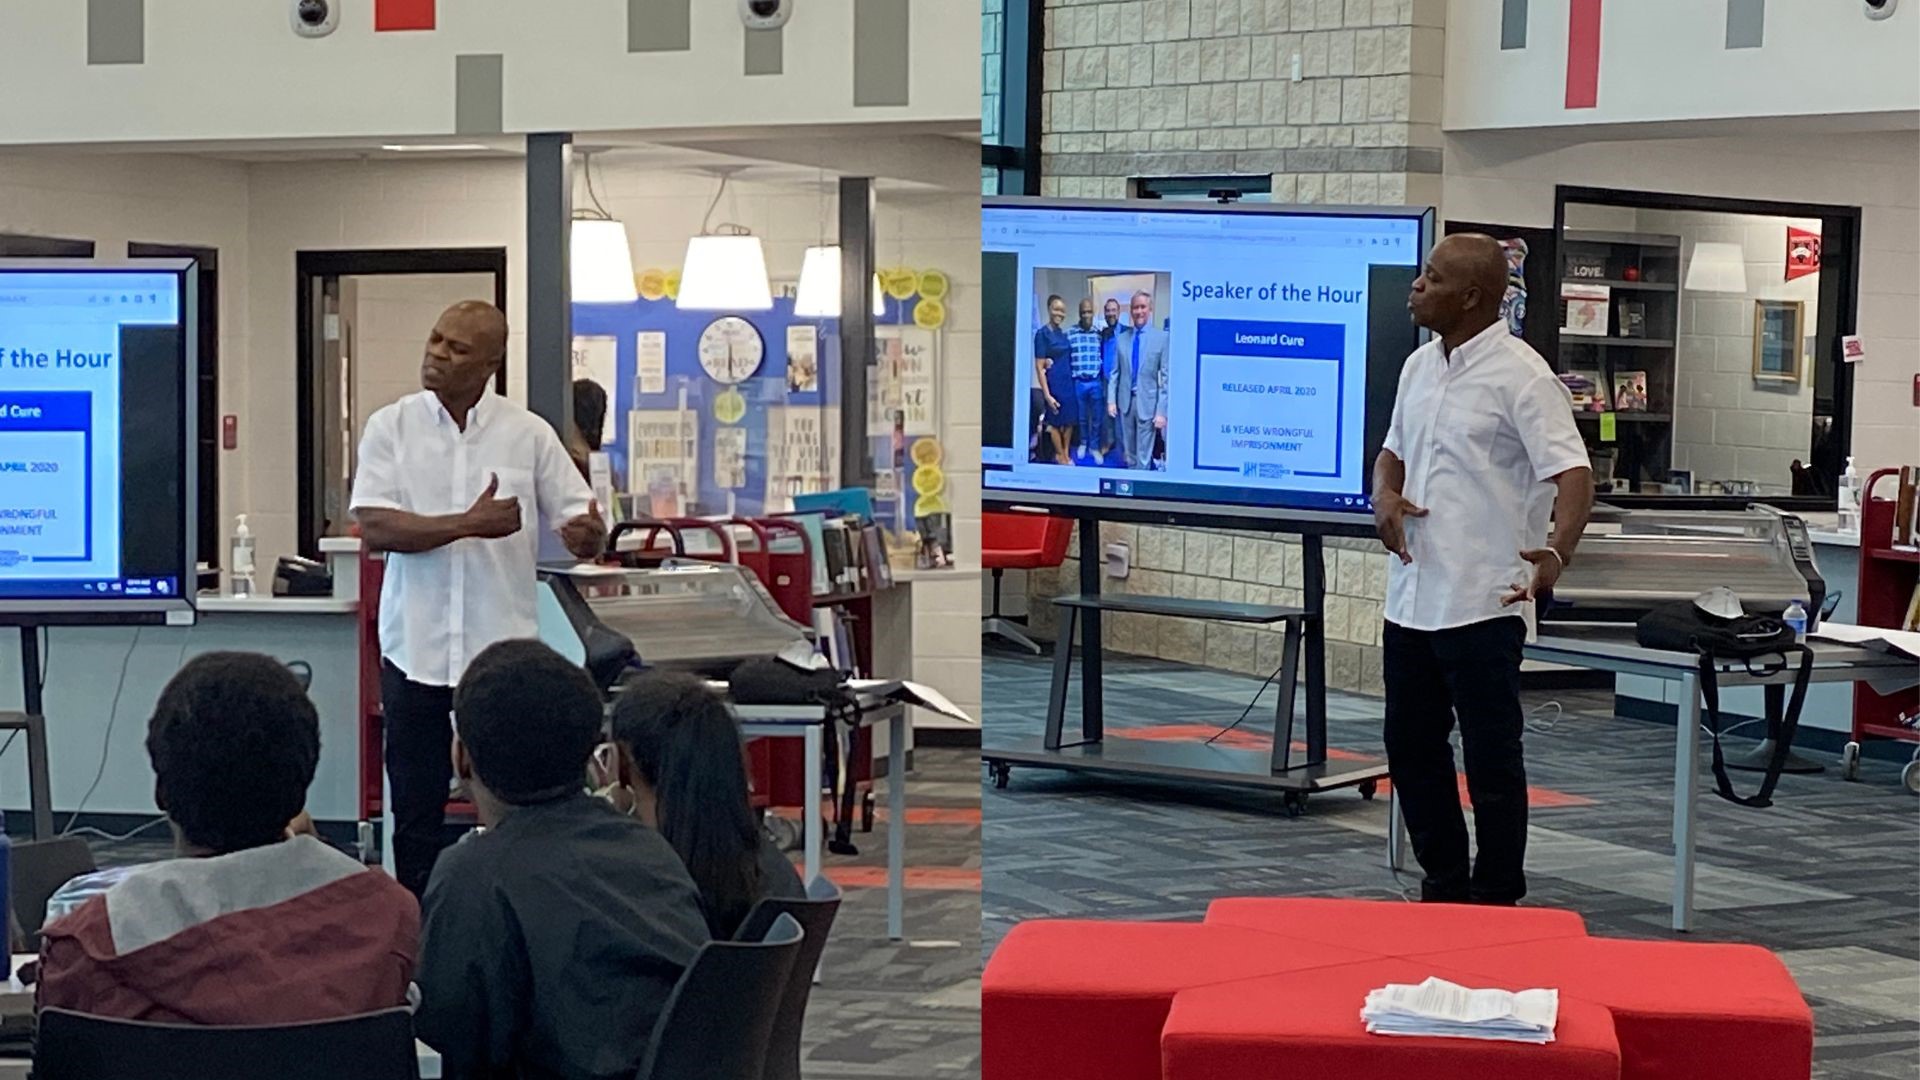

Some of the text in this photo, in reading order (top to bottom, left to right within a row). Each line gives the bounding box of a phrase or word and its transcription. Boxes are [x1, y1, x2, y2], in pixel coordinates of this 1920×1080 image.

[1574, 266, 1604, 277] LOVE.
[1182, 280, 1363, 304] Speaker of the Hour
[1235, 332, 1305, 347] Leonard Cure
[10, 347, 49, 368] the
[56, 349, 112, 368] Hour
[1222, 383, 1317, 396] RELEASED APRIL 2020
[10, 404, 42, 418] Cure
[1221, 424, 1314, 438] 16 YEARS WRONGFUL
[1231, 440, 1303, 452] IMPRISONMENT
[30, 462, 59, 473] 2020
